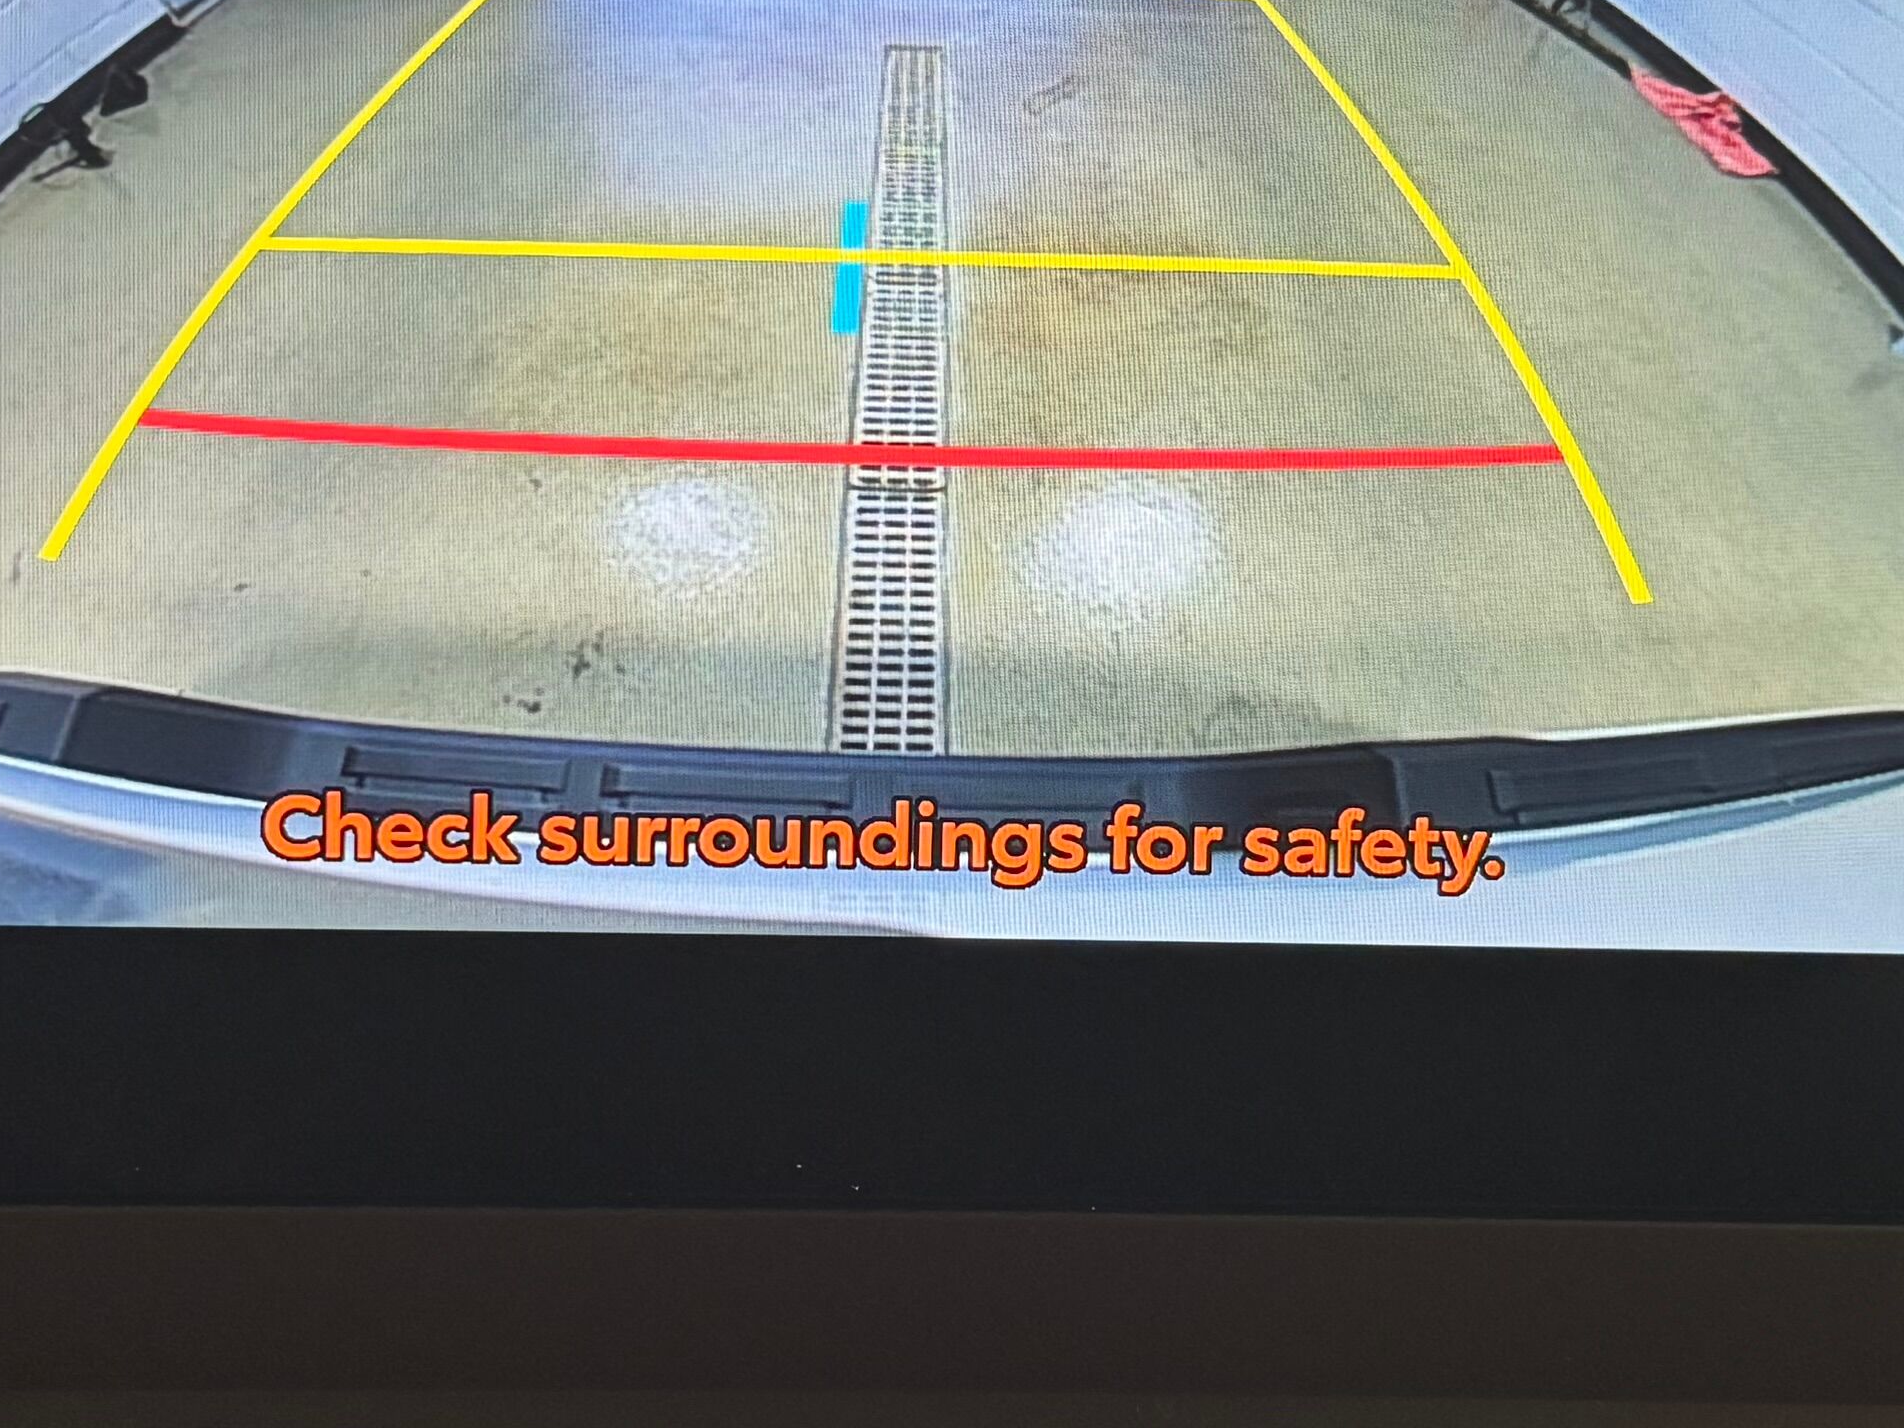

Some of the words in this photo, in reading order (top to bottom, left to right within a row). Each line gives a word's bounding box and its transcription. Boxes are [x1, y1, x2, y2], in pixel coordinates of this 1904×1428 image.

[262, 789, 520, 862] Check
[539, 799, 1088, 888] surroundings
[1105, 803, 1225, 873] for
[1243, 807, 1505, 895] safety.
